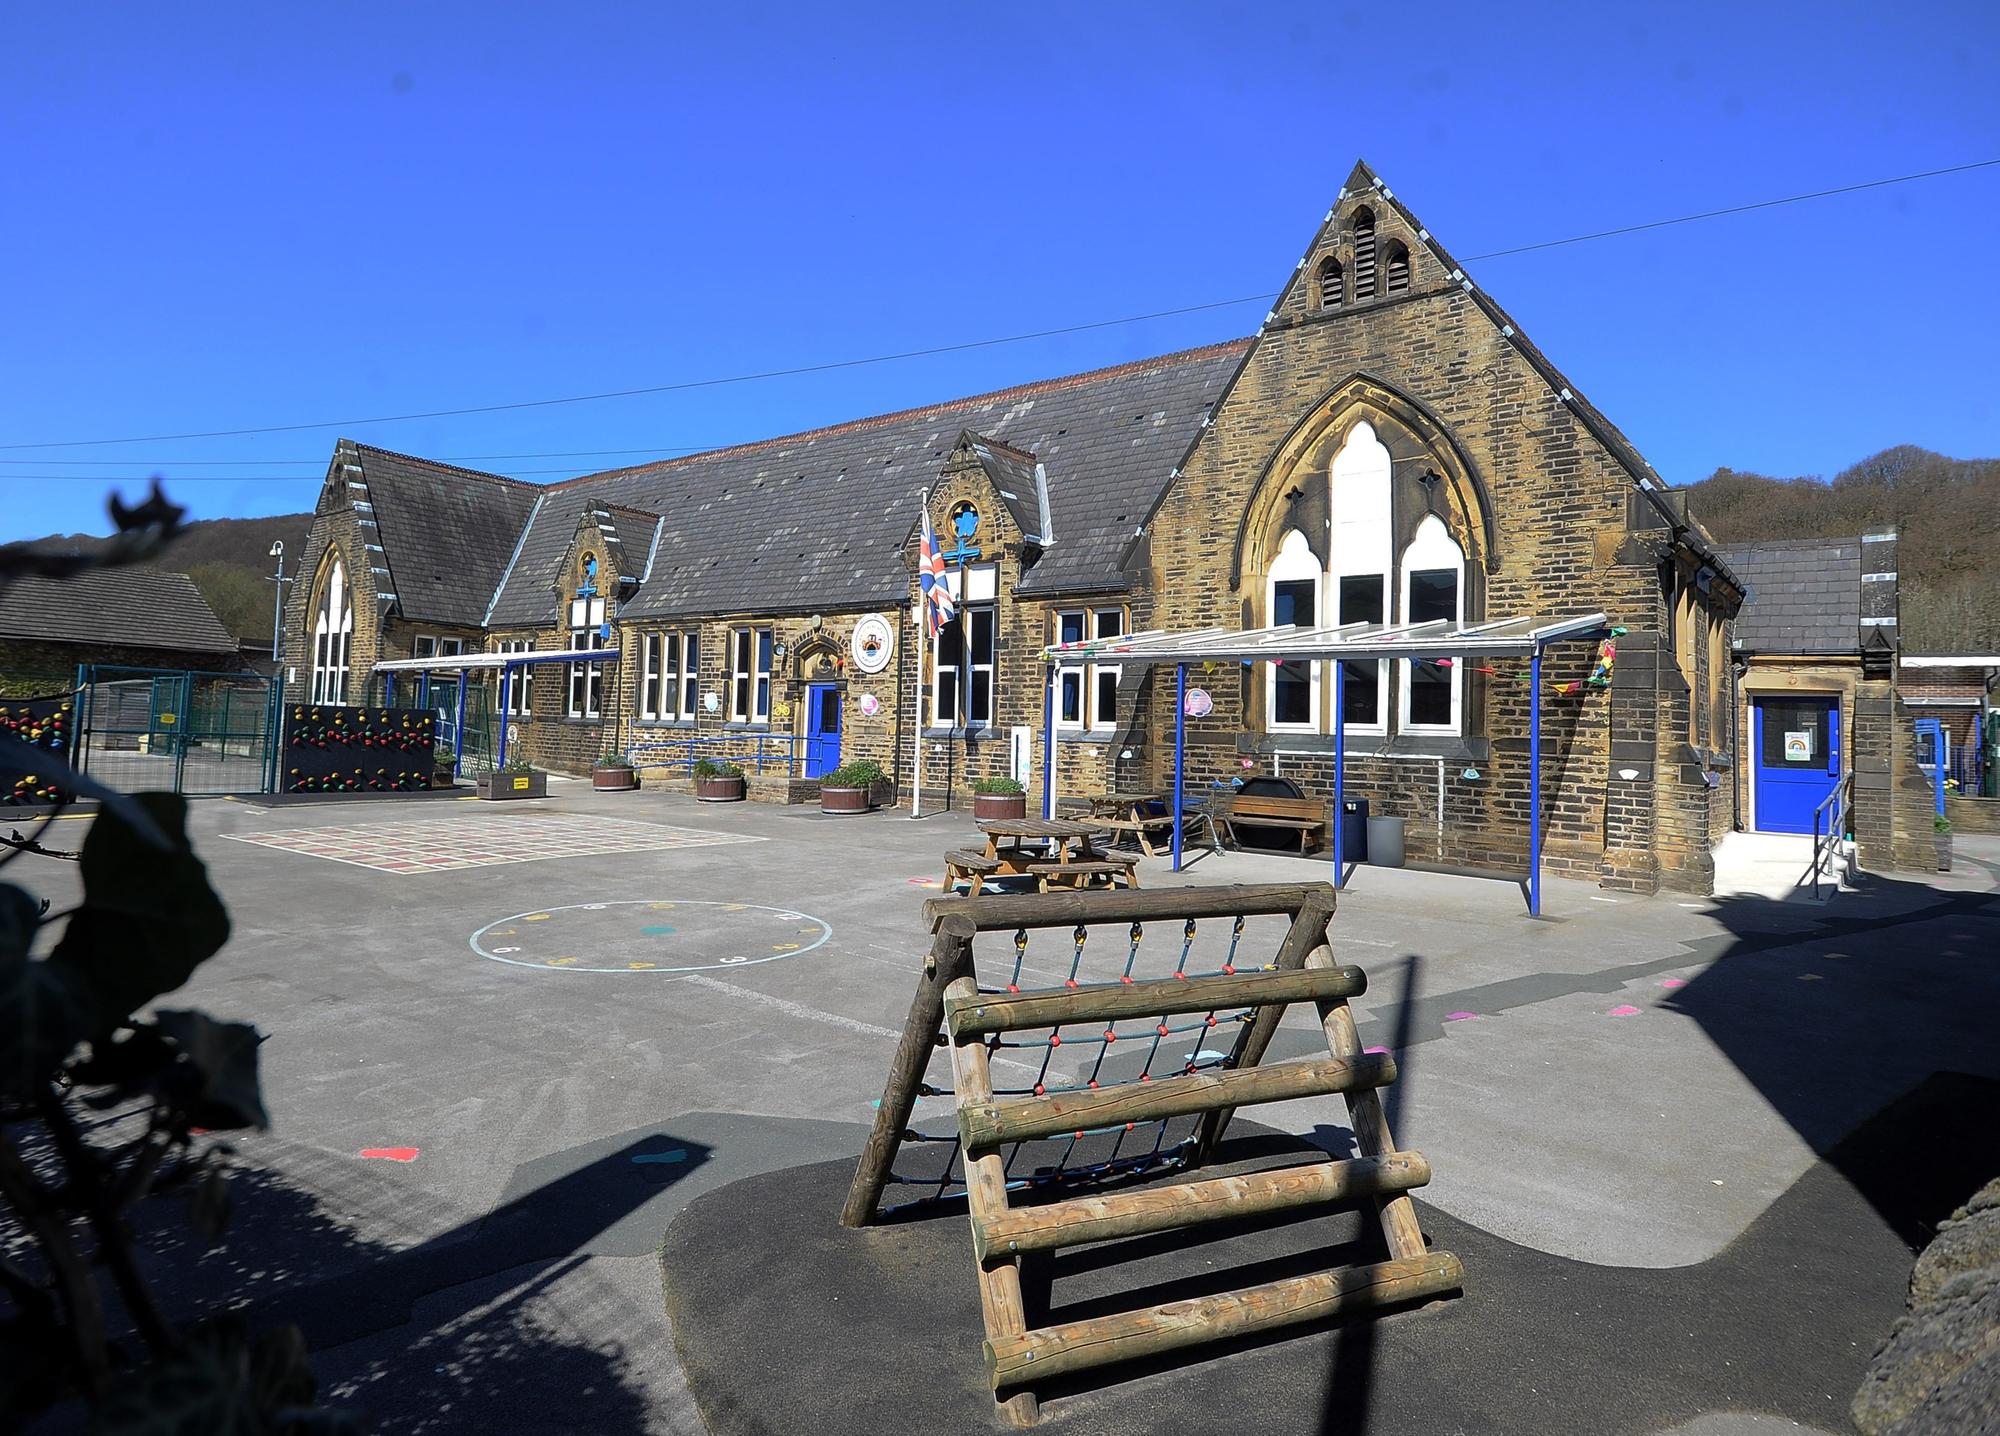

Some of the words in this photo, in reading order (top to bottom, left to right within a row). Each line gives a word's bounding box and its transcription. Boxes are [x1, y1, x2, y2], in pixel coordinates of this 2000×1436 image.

[492, 946, 521, 954] 6
[772, 943, 800, 951] 2
[719, 956, 748, 964] 3
